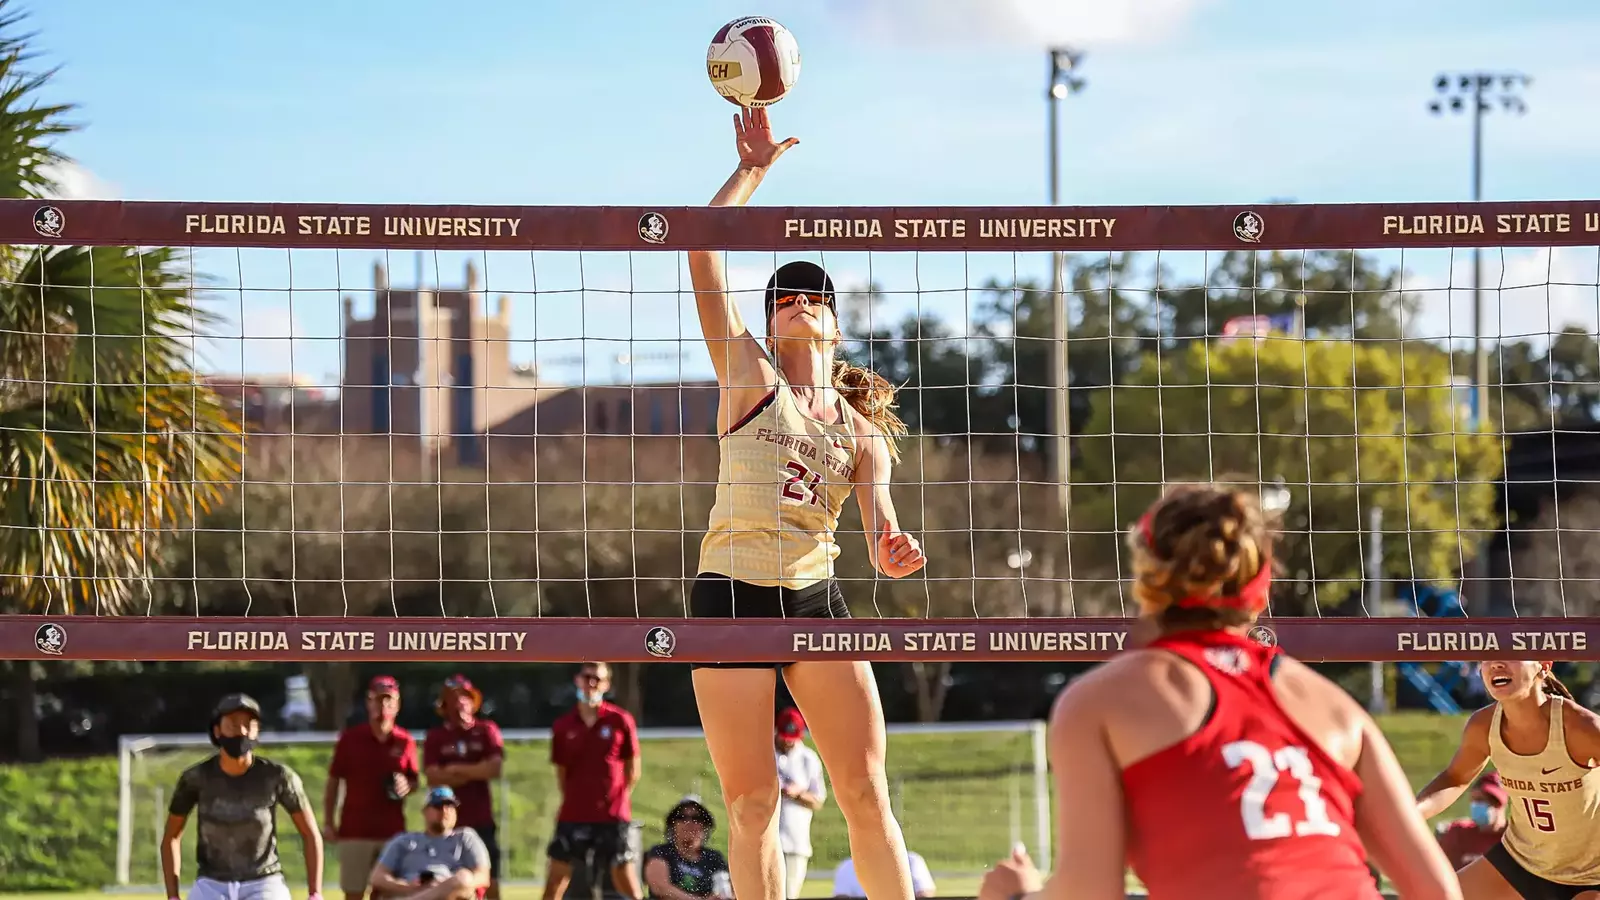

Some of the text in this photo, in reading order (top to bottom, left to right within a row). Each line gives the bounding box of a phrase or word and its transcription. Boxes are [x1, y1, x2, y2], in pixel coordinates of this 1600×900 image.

[707, 63, 729, 79] ACH
[185, 214, 522, 237] FLORIDA STATE UNIVERSITY
[784, 218, 1117, 238] FLORIDA STATE UNIVERSITY
[1383, 214, 1485, 235] FLORIDA
[1496, 213, 1570, 233] STATE
[755, 428, 818, 461] FLORIDA
[782, 460, 823, 506] 21
[187, 630, 528, 651] FLORIDA STATE UNIVERSITY
[792, 631, 1128, 652] FLORIDA STATE UNIVERSITY
[1397, 631, 1587, 651] FLORIDA STATE
[1221, 740, 1341, 840] 21
[1501, 776, 1583, 793] ORIDA STATE
[1522, 797, 1556, 833] 15
